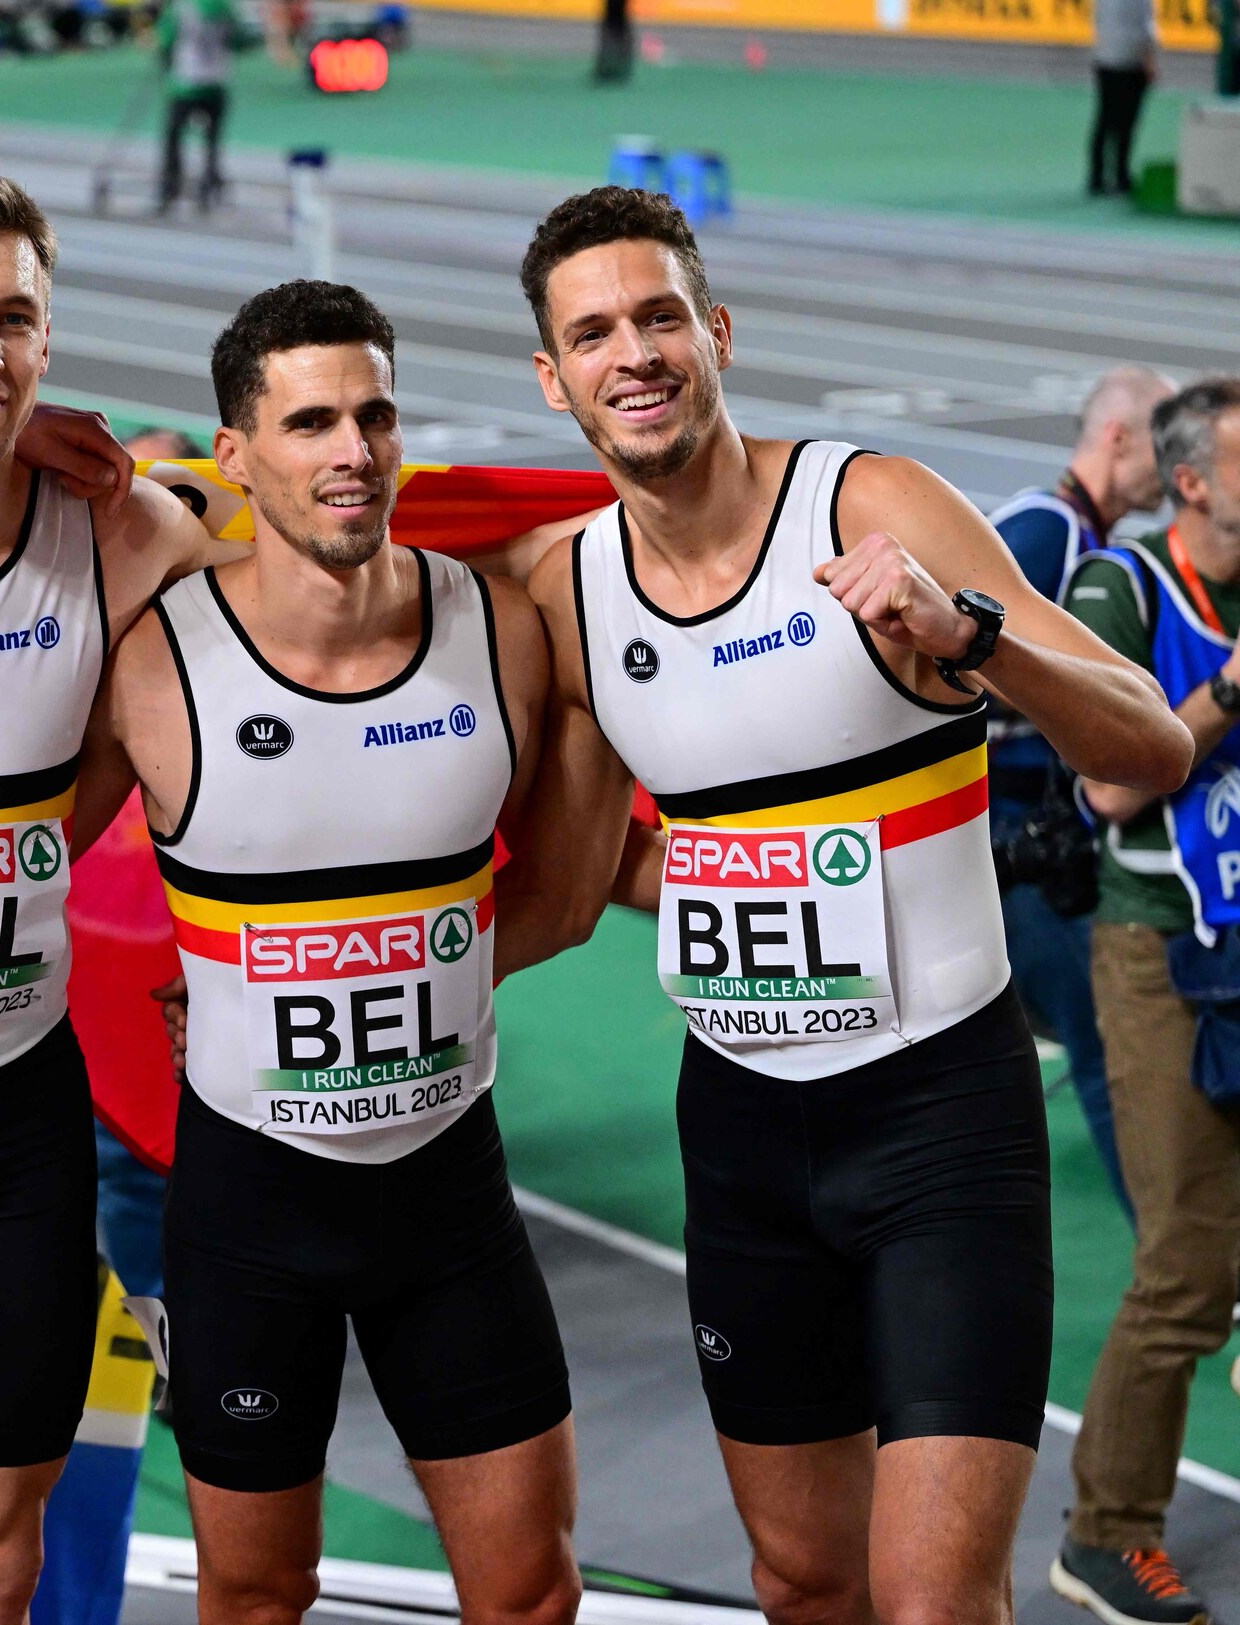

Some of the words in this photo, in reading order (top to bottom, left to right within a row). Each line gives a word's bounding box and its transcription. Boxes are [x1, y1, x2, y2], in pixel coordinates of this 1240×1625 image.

[713, 629, 785, 668] Allianz
[628, 663, 655, 674] vermarc
[245, 740, 285, 750] vermarc
[363, 718, 446, 748] Allianz
[668, 837, 803, 880] SPAR
[250, 924, 421, 975] SPAR
[677, 898, 862, 979] BEL
[698, 978, 704, 996] I
[708, 979, 750, 998] RUN
[273, 980, 459, 1071] BEL
[802, 1006, 879, 1034] 2023
[301, 1072, 308, 1089] I
[314, 1068, 362, 1089] RUN
[270, 1092, 406, 1125] ISTANBUL
[410, 1075, 462, 1113] 2023
[229, 1405, 270, 1414] vermarc
